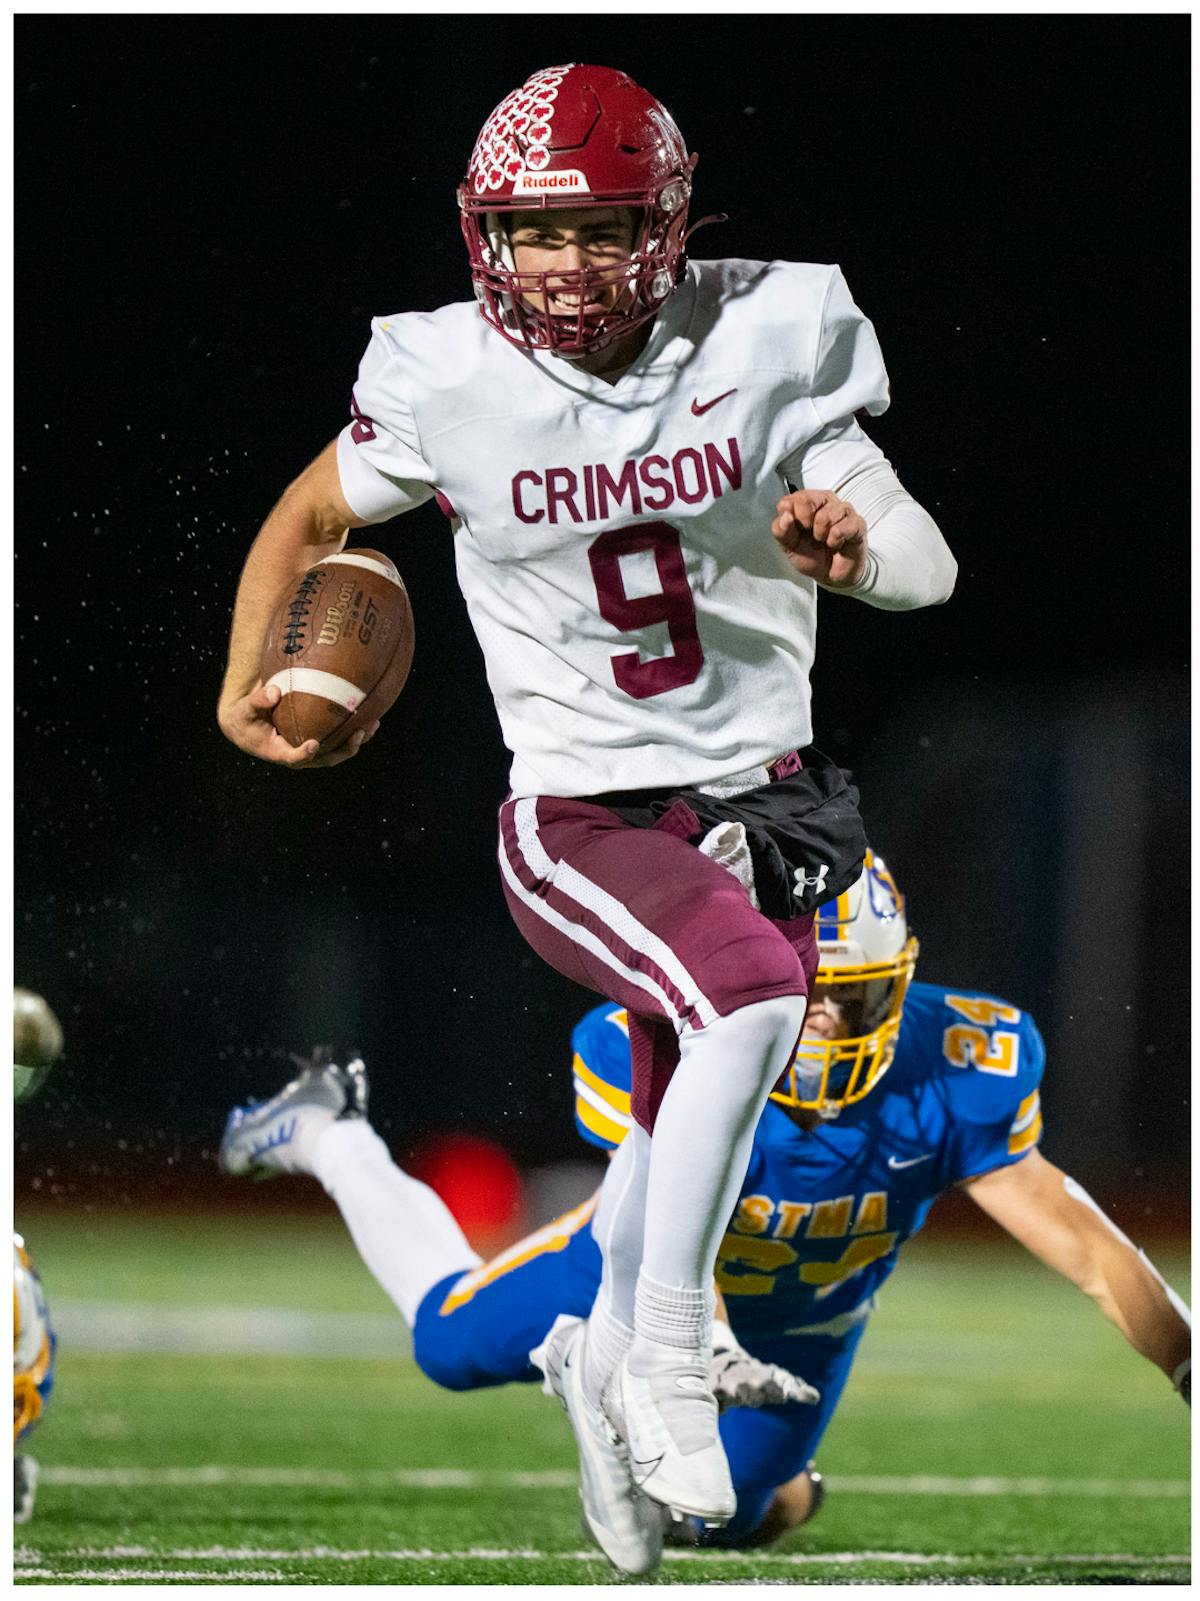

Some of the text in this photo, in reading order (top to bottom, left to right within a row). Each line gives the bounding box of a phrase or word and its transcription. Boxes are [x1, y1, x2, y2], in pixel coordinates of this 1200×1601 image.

[522, 174, 579, 188] Riddell
[512, 437, 743, 525] CRIMSON
[317, 581, 356, 647] Wilson
[359, 595, 380, 646] GST
[587, 521, 705, 700] 9
[943, 994, 1021, 1077] 24
[732, 1191, 889, 1239] STMA
